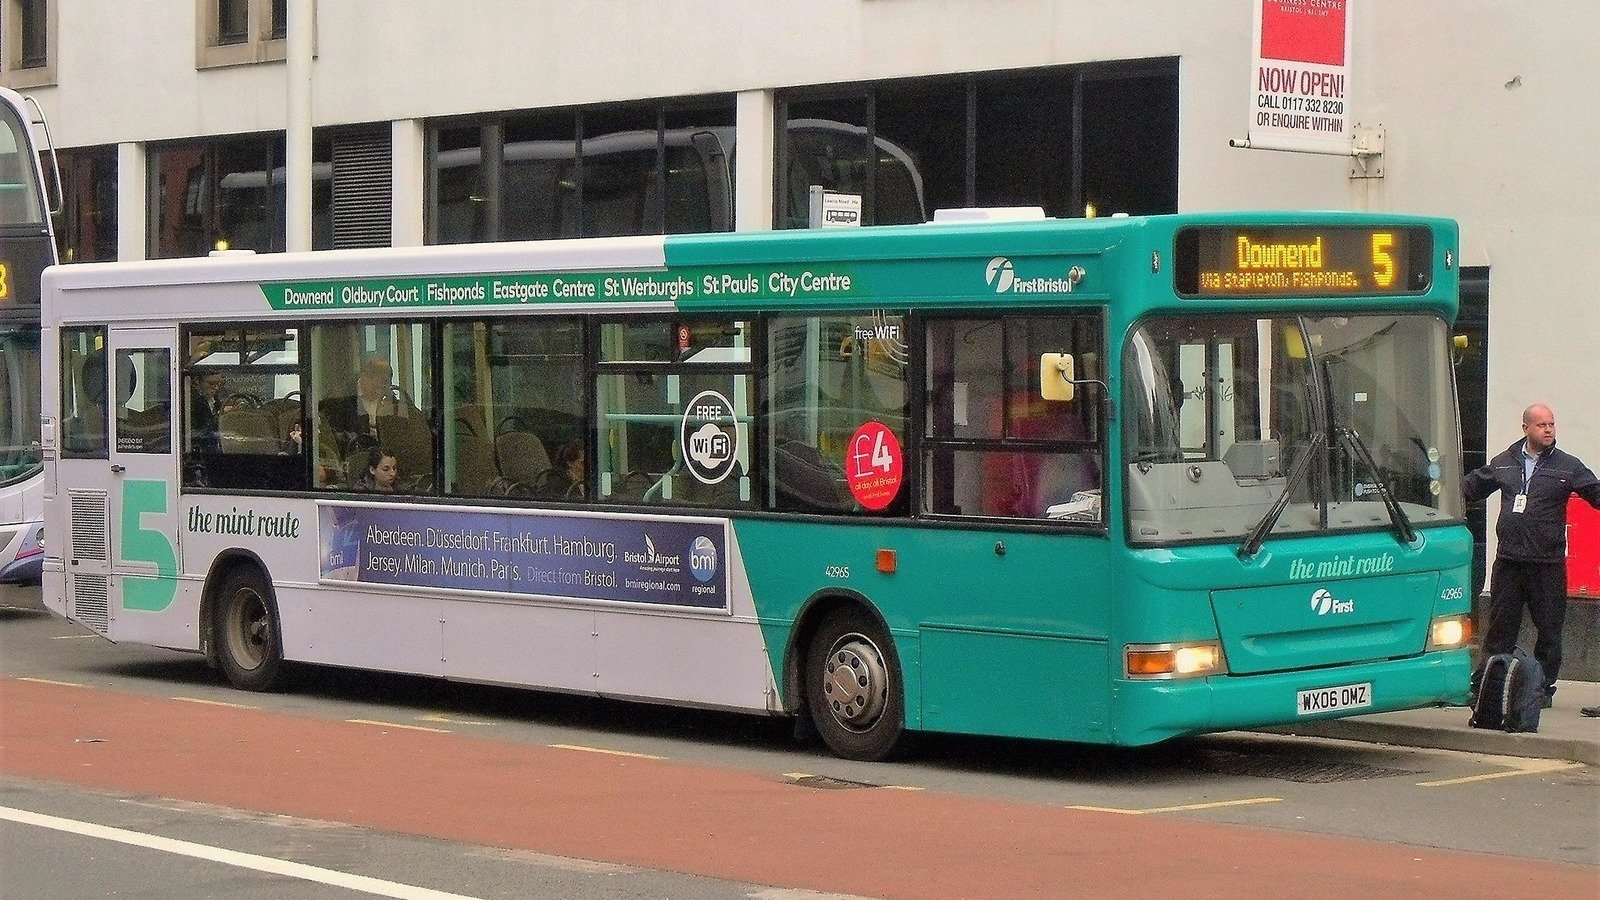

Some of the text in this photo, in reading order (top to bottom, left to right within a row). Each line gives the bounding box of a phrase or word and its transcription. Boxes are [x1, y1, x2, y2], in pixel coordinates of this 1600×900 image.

[1311, 0, 1342, 10] CENTRE
[1259, 67, 1344, 98] NOW OPEN!
[1258, 94, 1344, 114] CALL 0117 332 8230
[1257, 112, 1343, 132] OR ENQUIRE WITHIN
[1238, 233, 1394, 287] Downend 5
[284, 270, 851, 307] Downend Oldbury Court Fishponds Eastgate Centre St Werburghs St Pauls City Centre
[855, 325, 900, 340] free WiFi
[696, 405, 722, 421] FREE
[852, 430, 893, 477] £4
[188, 505, 300, 539] the mint route
[120, 479, 178, 612] 5
[366, 525, 618, 563] Aberdeen. Düsseldorf. Frankfurt. Hamburg.
[624, 551, 680, 567] Bristol Airport
[690, 550, 716, 571] bmi
[1289, 552, 1394, 580] the mint route
[366, 552, 618, 588] Jersey. Milan. Munich. Paris. Direct from Bristol.
[825, 565, 850, 579] 42965
[625, 578, 681, 592] bmiregional.com
[691, 584, 716, 596] regional
[1440, 587, 1463, 601] 42965
[1332, 599, 1355, 614] First
[1302, 686, 1366, 711] WX06 OMZ
